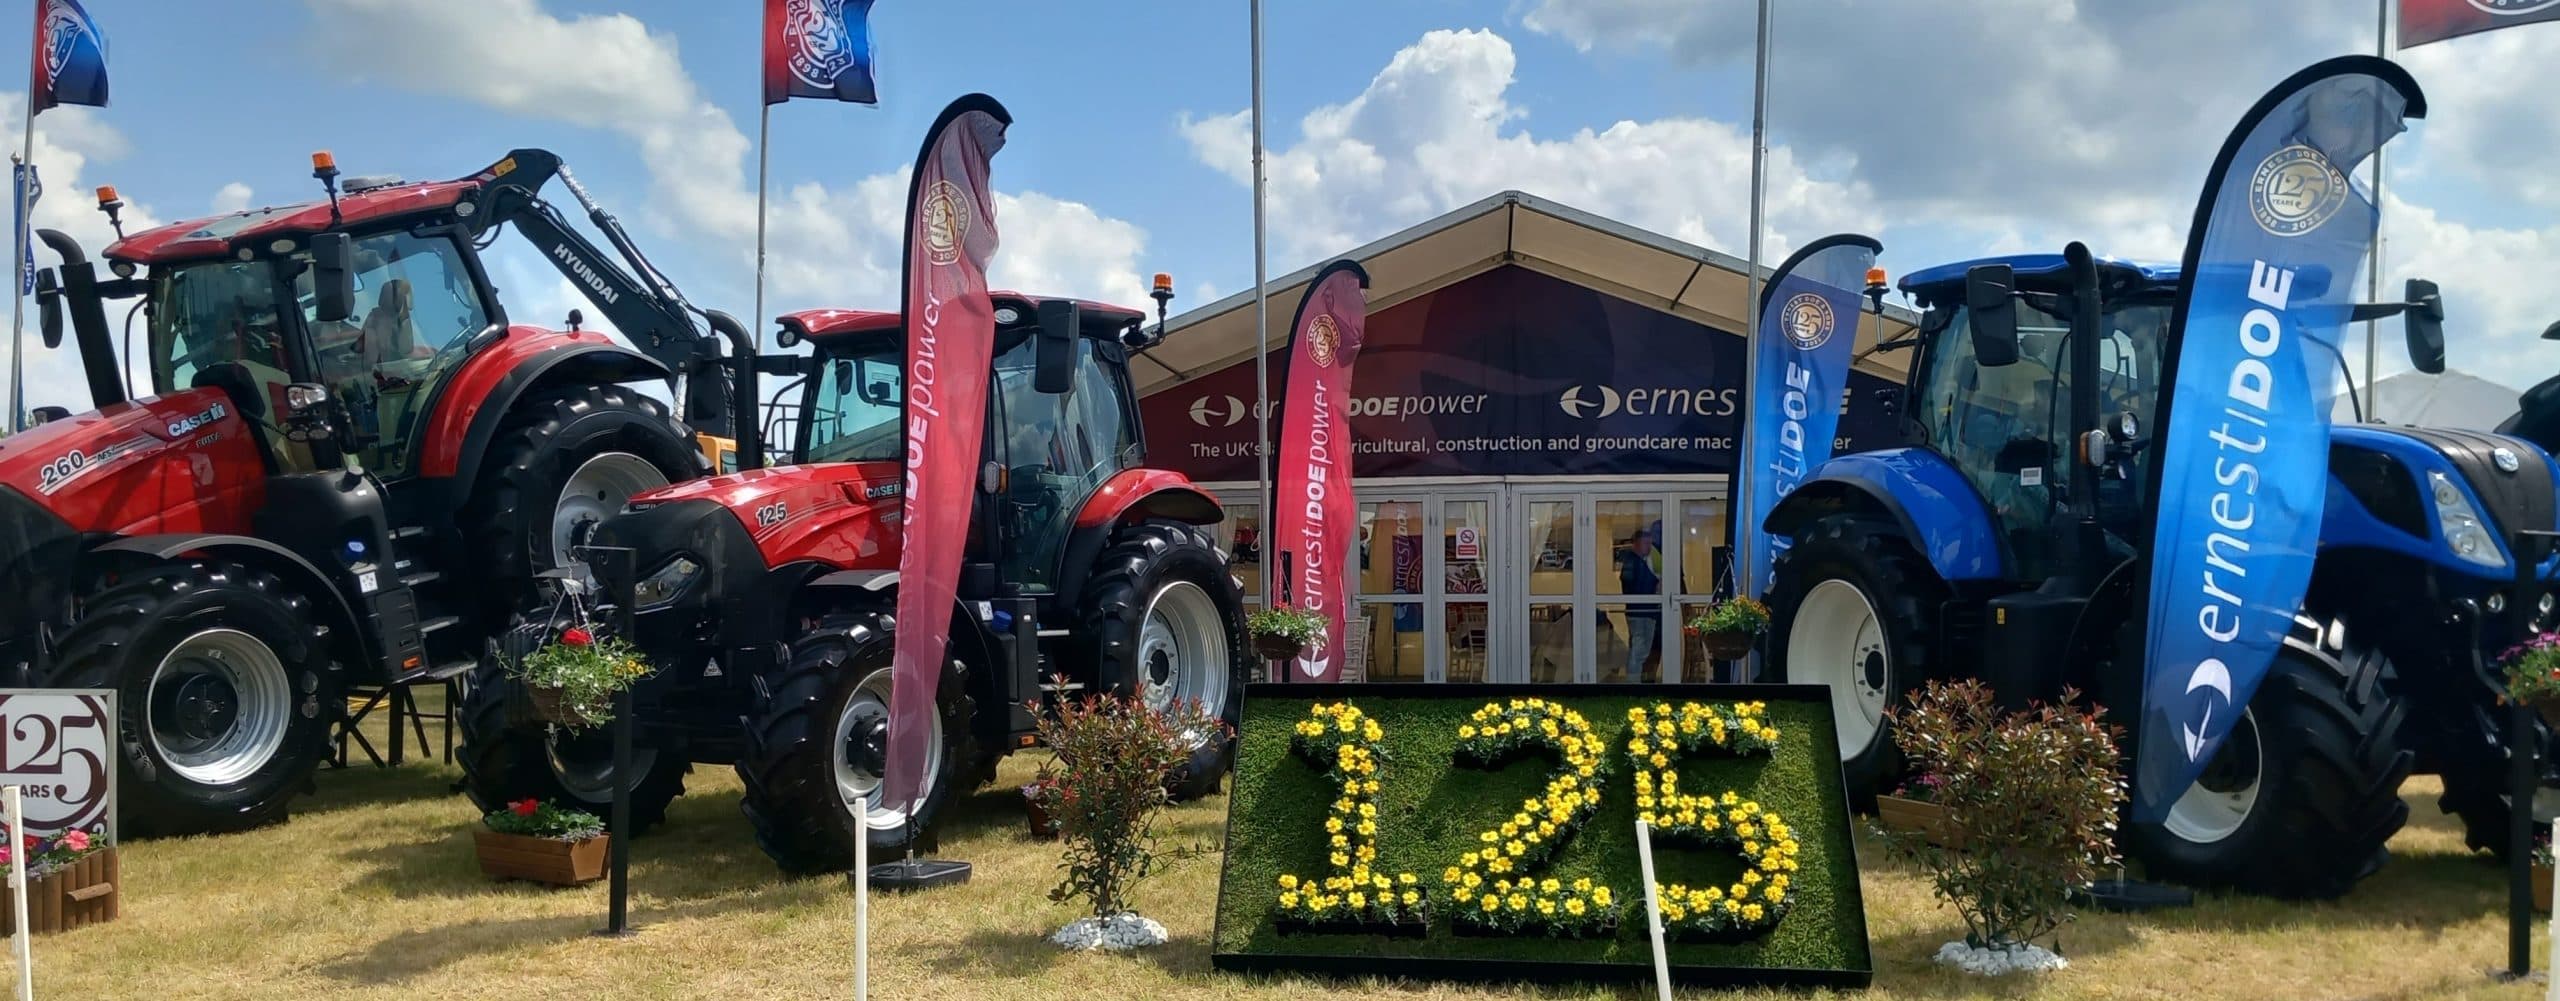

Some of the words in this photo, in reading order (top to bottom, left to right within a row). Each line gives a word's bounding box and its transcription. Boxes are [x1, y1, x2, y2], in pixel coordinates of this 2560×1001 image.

[792, 52, 819, 78] 1898
[2274, 171, 2326, 209] 125
[554, 243, 619, 305] HYUNDAI
[1190, 443, 1220, 457] The
[1225, 442, 1262, 457] UK's
[1351, 438, 1430, 455] ricultural,
[1436, 435, 1542, 452] construction
[1547, 434, 1580, 450] and
[1585, 434, 1688, 453] groundcare
[1694, 435, 1732, 450] mac
[42, 450, 84, 487] 260
[756, 502, 788, 528] 125
[1277, 698, 1798, 928] 125
